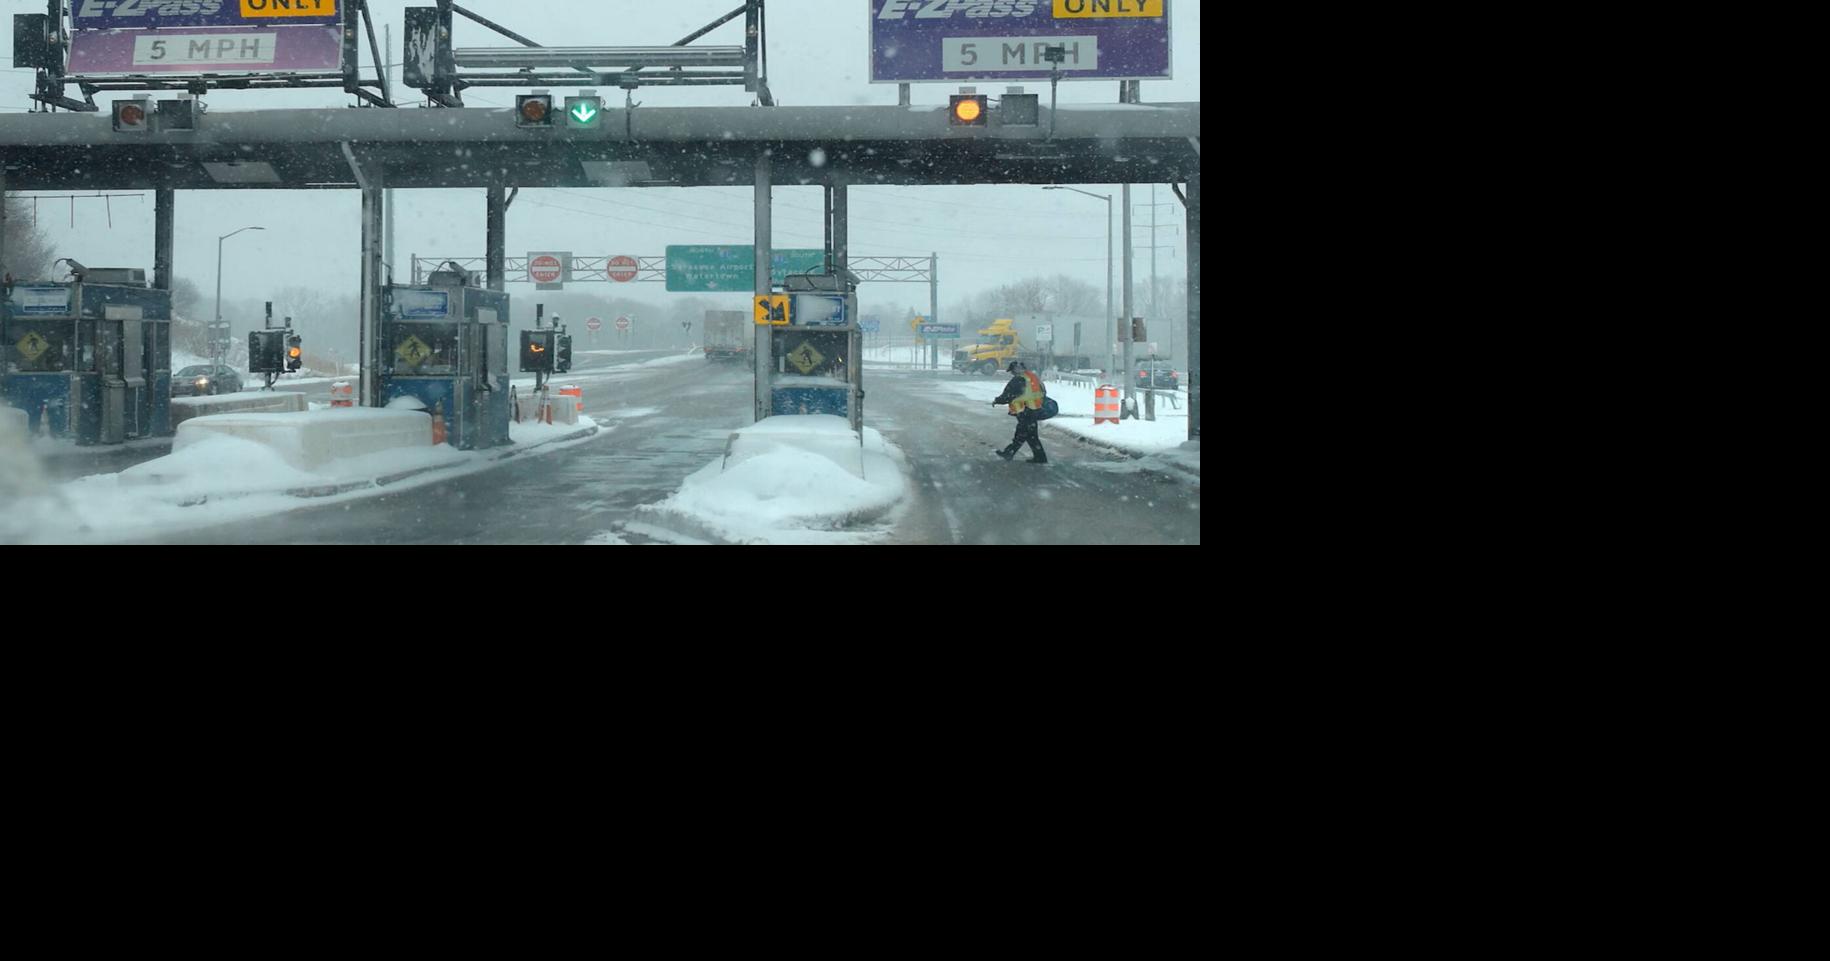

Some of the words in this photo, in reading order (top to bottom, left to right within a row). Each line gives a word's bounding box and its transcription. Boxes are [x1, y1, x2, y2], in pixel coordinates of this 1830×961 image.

[79, 0, 222, 17] E-ZPass
[249, 0, 323, 10] ONLY
[877, 0, 1037, 19] E-ZPass
[1064, 0, 1146, 13] ONLY
[150, 40, 166, 60] 5
[188, 38, 260, 59] MPH
[960, 43, 978, 66] 5
[1002, 42, 1079, 65] MPH
